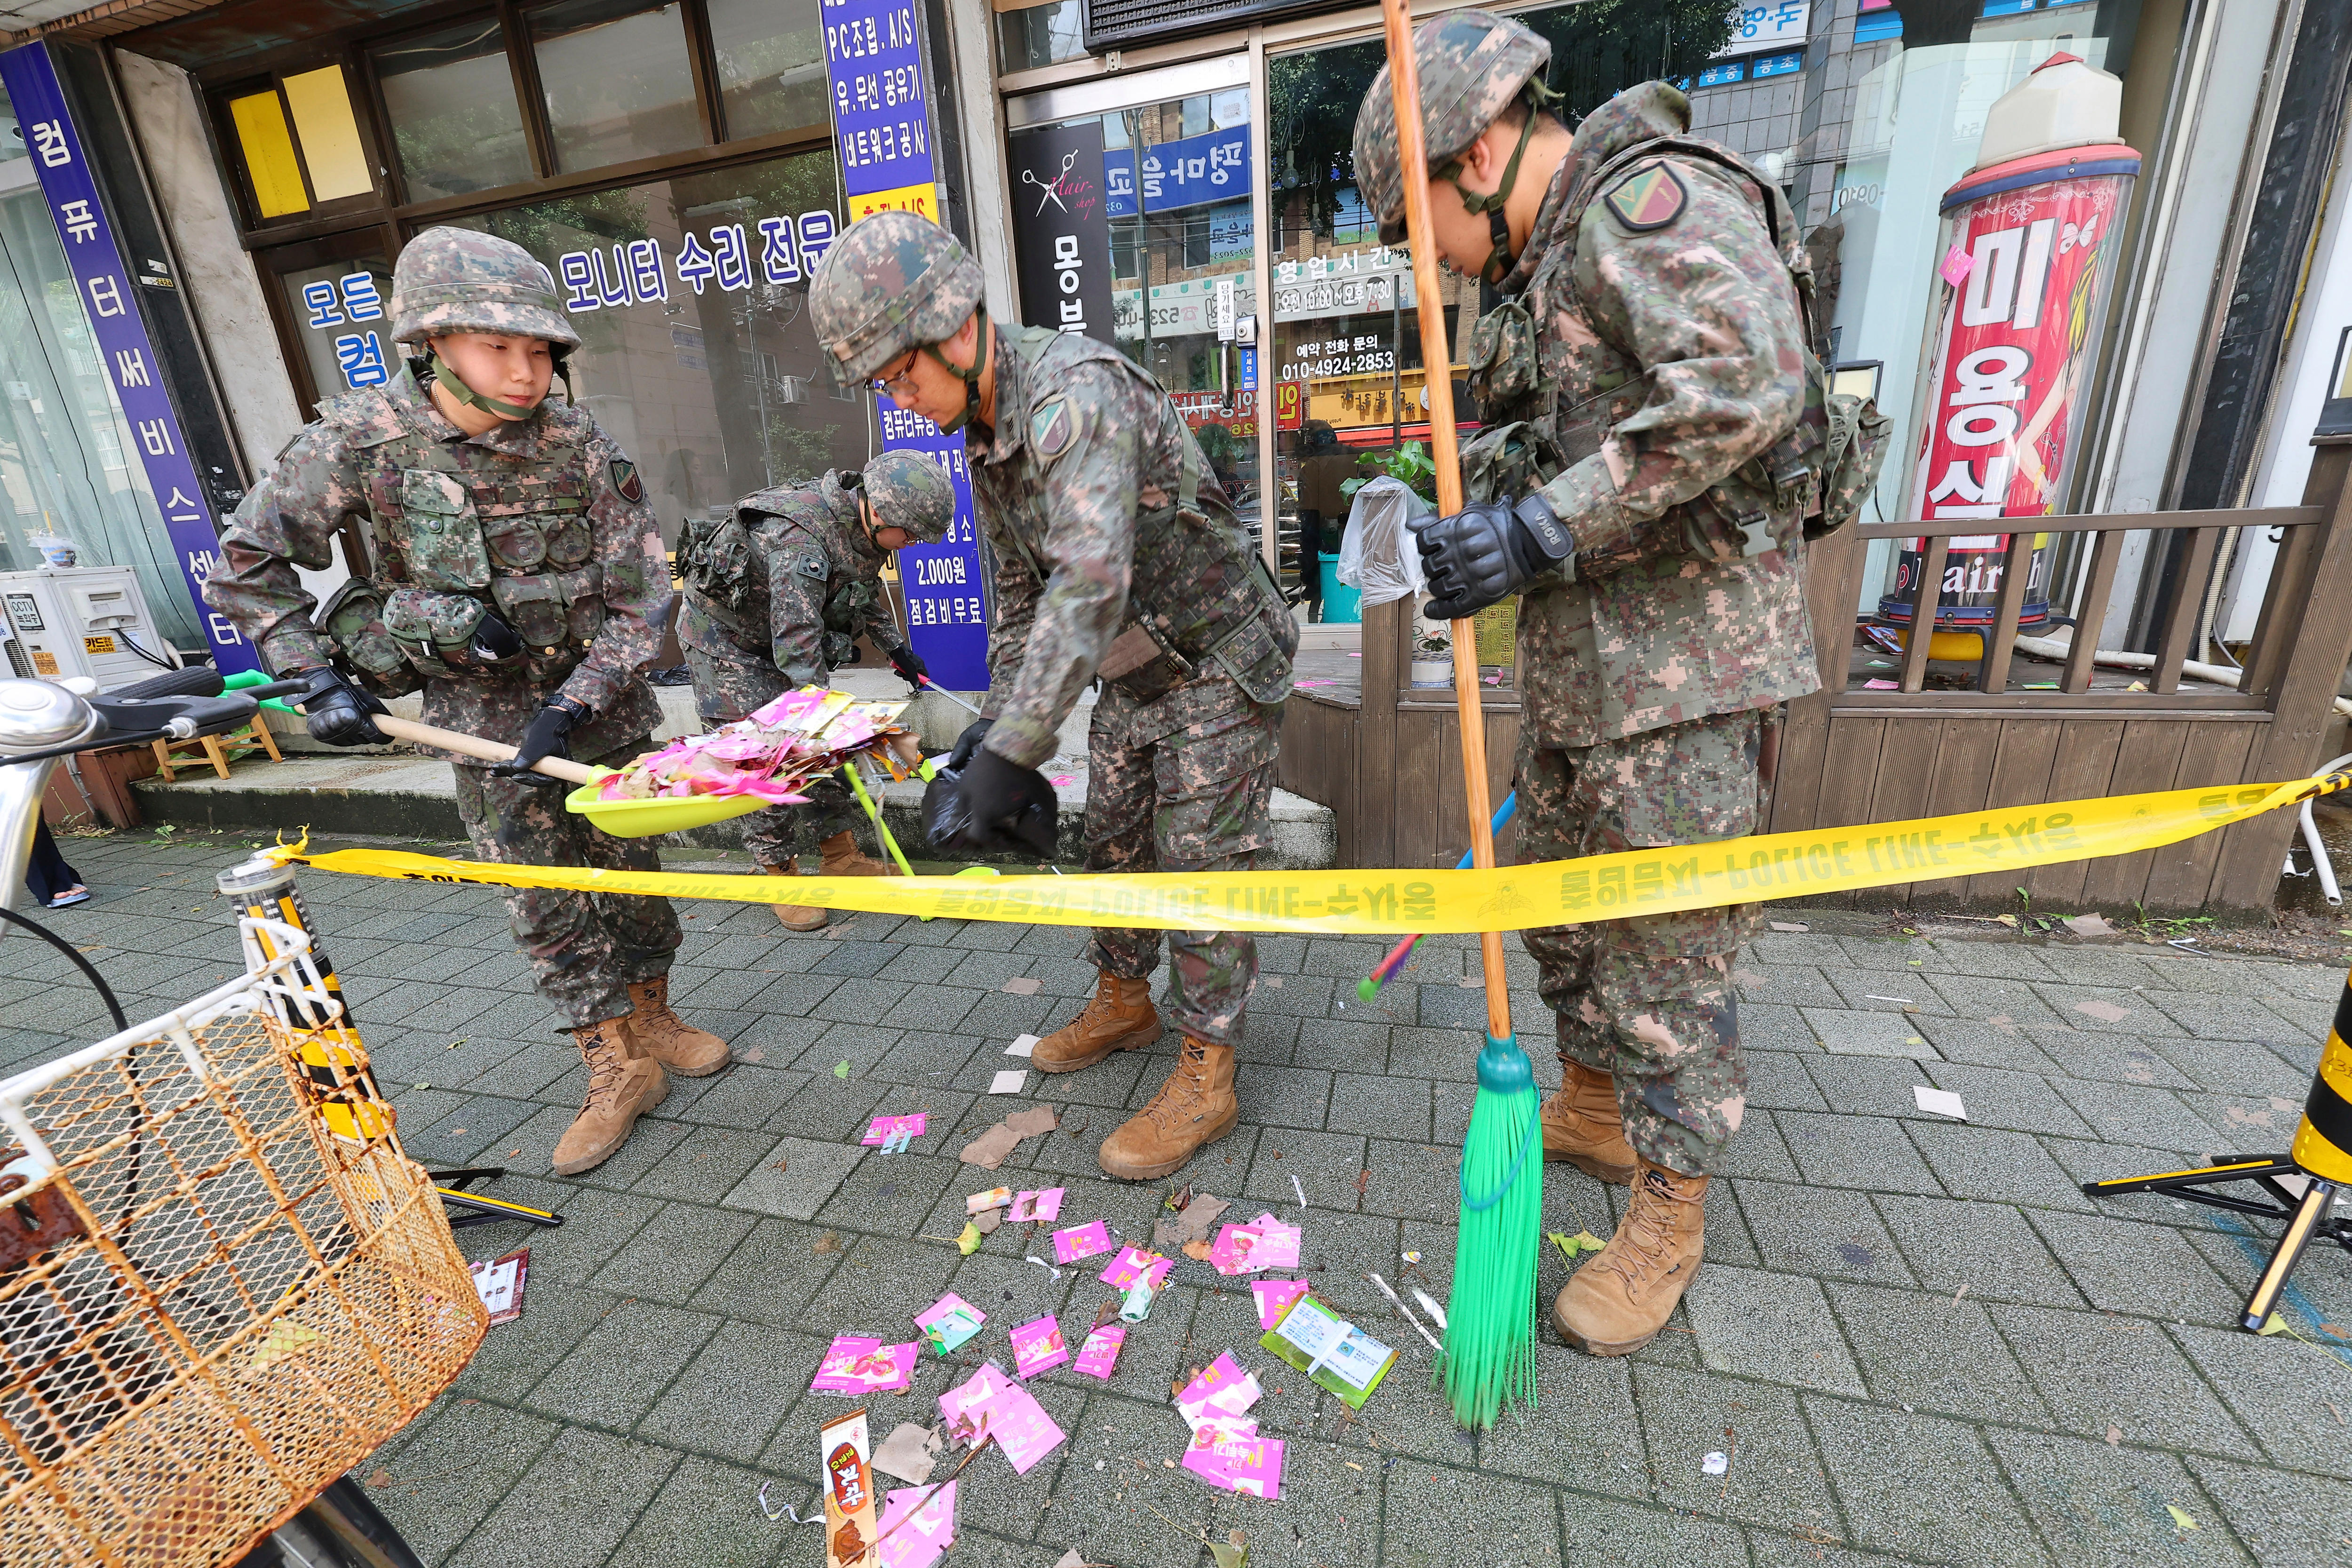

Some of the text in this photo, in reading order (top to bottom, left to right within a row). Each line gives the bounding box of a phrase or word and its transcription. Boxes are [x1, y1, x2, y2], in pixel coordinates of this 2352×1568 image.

[889, 8, 913, 49] A/S
[836, 64, 921, 116] 유.무선 공유기
[844, 119, 925, 168] 네트워크 공사
[1049, 171, 1093, 199] Hair
[1074, 196, 1095, 220] shop
[559, 210, 837, 313] 모니터 수리 전문
[302, 271, 382, 329] 모든
[1222, 284, 1230, 323] 당기세요
[1280, 292, 1301, 313] 오전
[1367, 280, 1391, 301] 7:30
[1296, 334, 1378, 358] 예약 전화 문의
[1282, 350, 1394, 381] 010-4924-2853
[1928, 218, 2055, 549] 미용실
[916, 556, 966, 585] 2.000원
[12, 601, 33, 612] CCTV
[910, 597, 982, 625] 점검비무료
[85, 637, 105, 648] 카드
